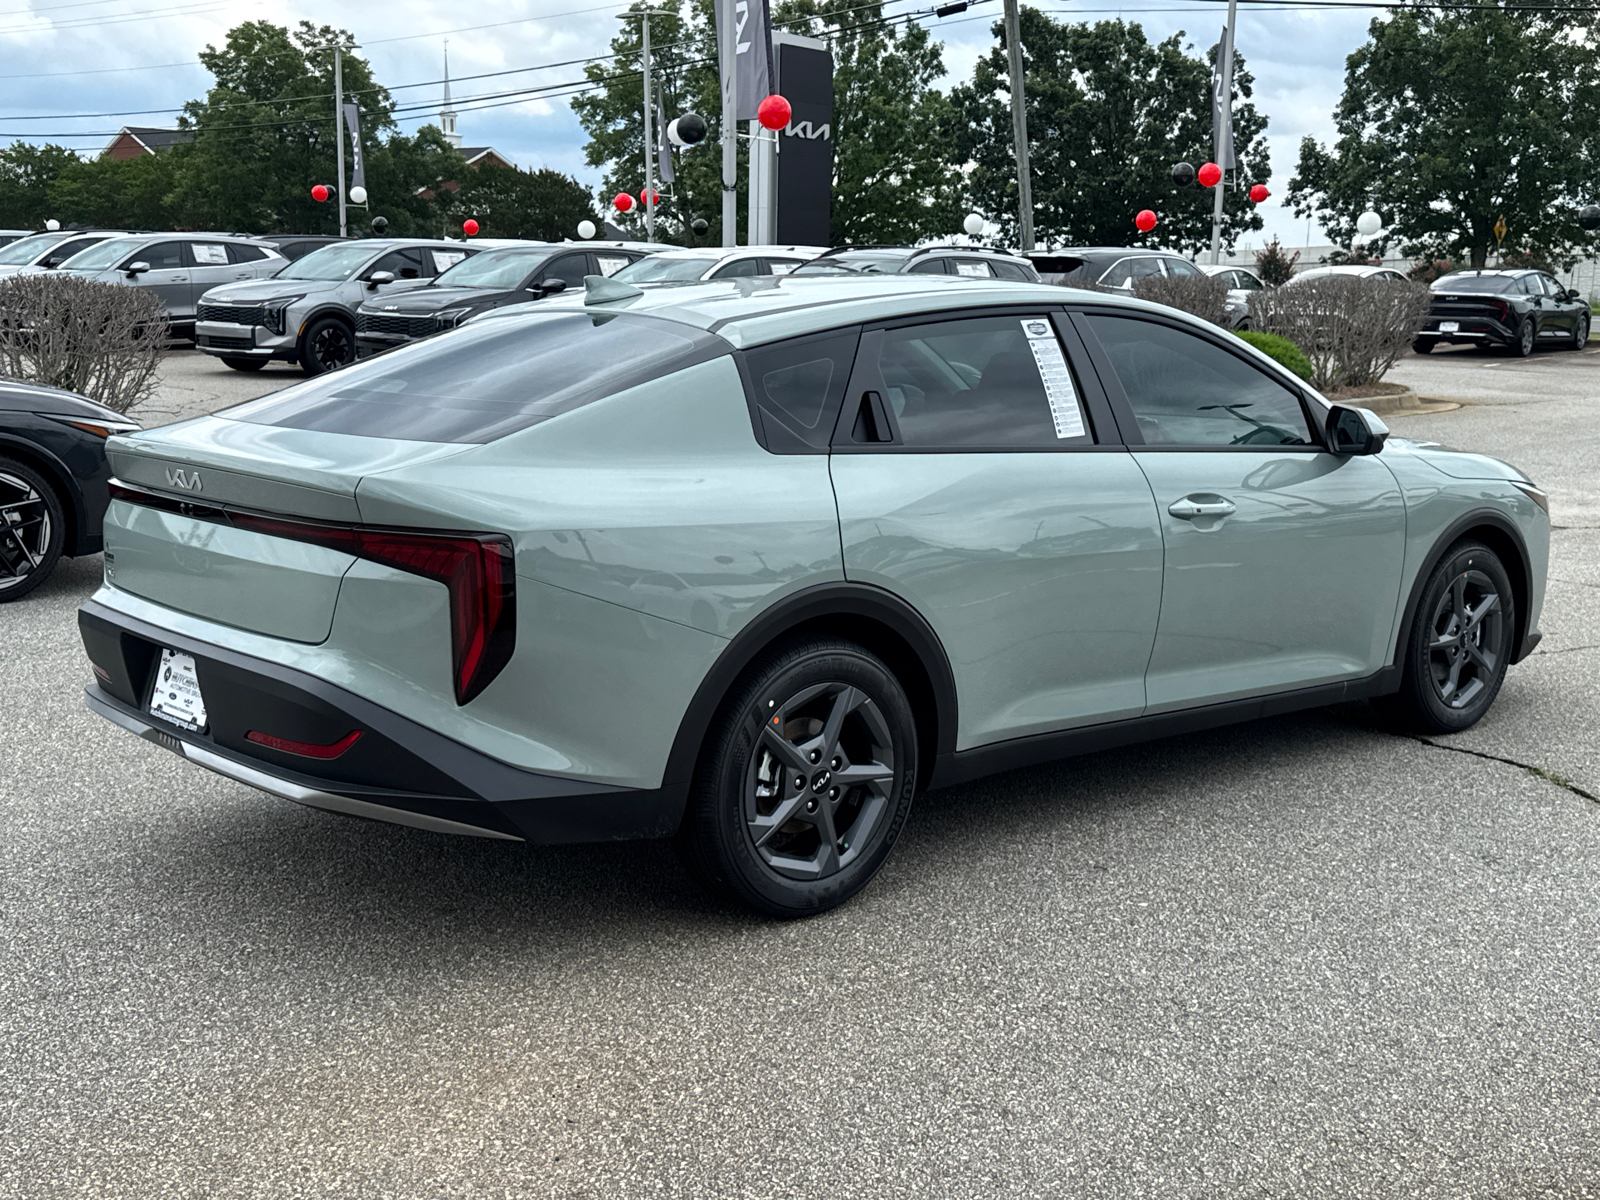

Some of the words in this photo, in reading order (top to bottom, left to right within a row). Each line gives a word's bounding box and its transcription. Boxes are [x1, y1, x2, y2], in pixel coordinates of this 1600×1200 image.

[785, 120, 830, 141] KIA
[165, 467, 203, 491] KIA
[812, 771, 830, 791] KIA
[884, 769, 914, 846] KUMHO
